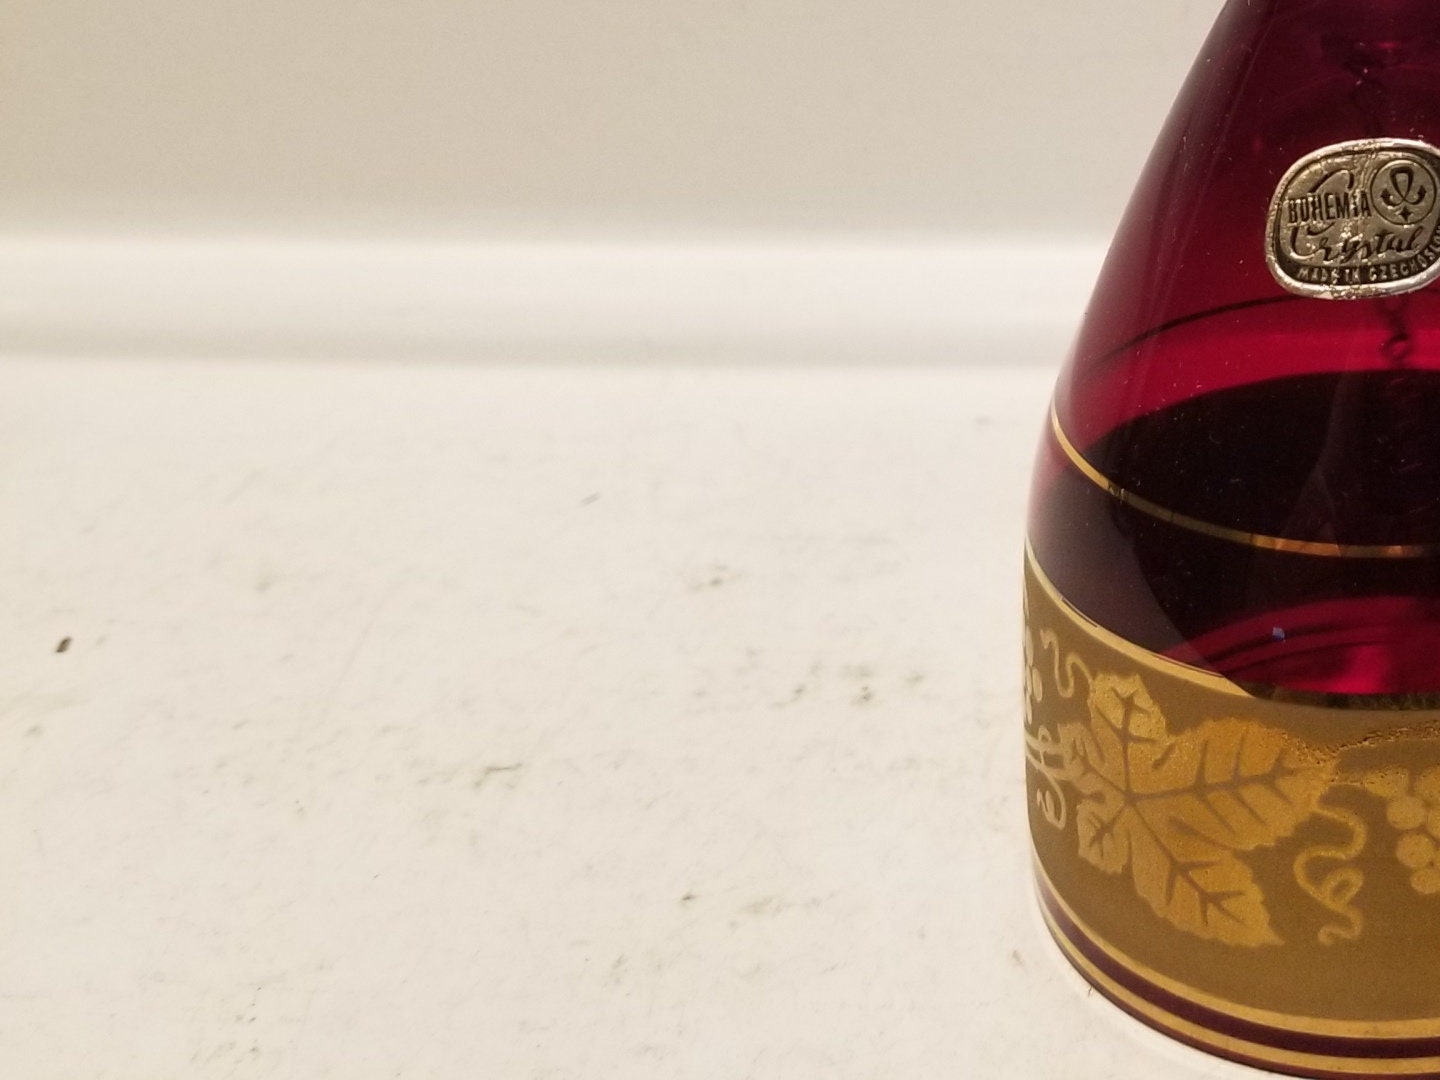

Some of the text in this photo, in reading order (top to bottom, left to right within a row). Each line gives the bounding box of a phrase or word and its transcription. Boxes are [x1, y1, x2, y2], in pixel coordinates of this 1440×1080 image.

[1287, 191, 1372, 223] BOHEMIA
[1297, 267, 1340, 283] MADE
[1344, 268, 1360, 282] IN
